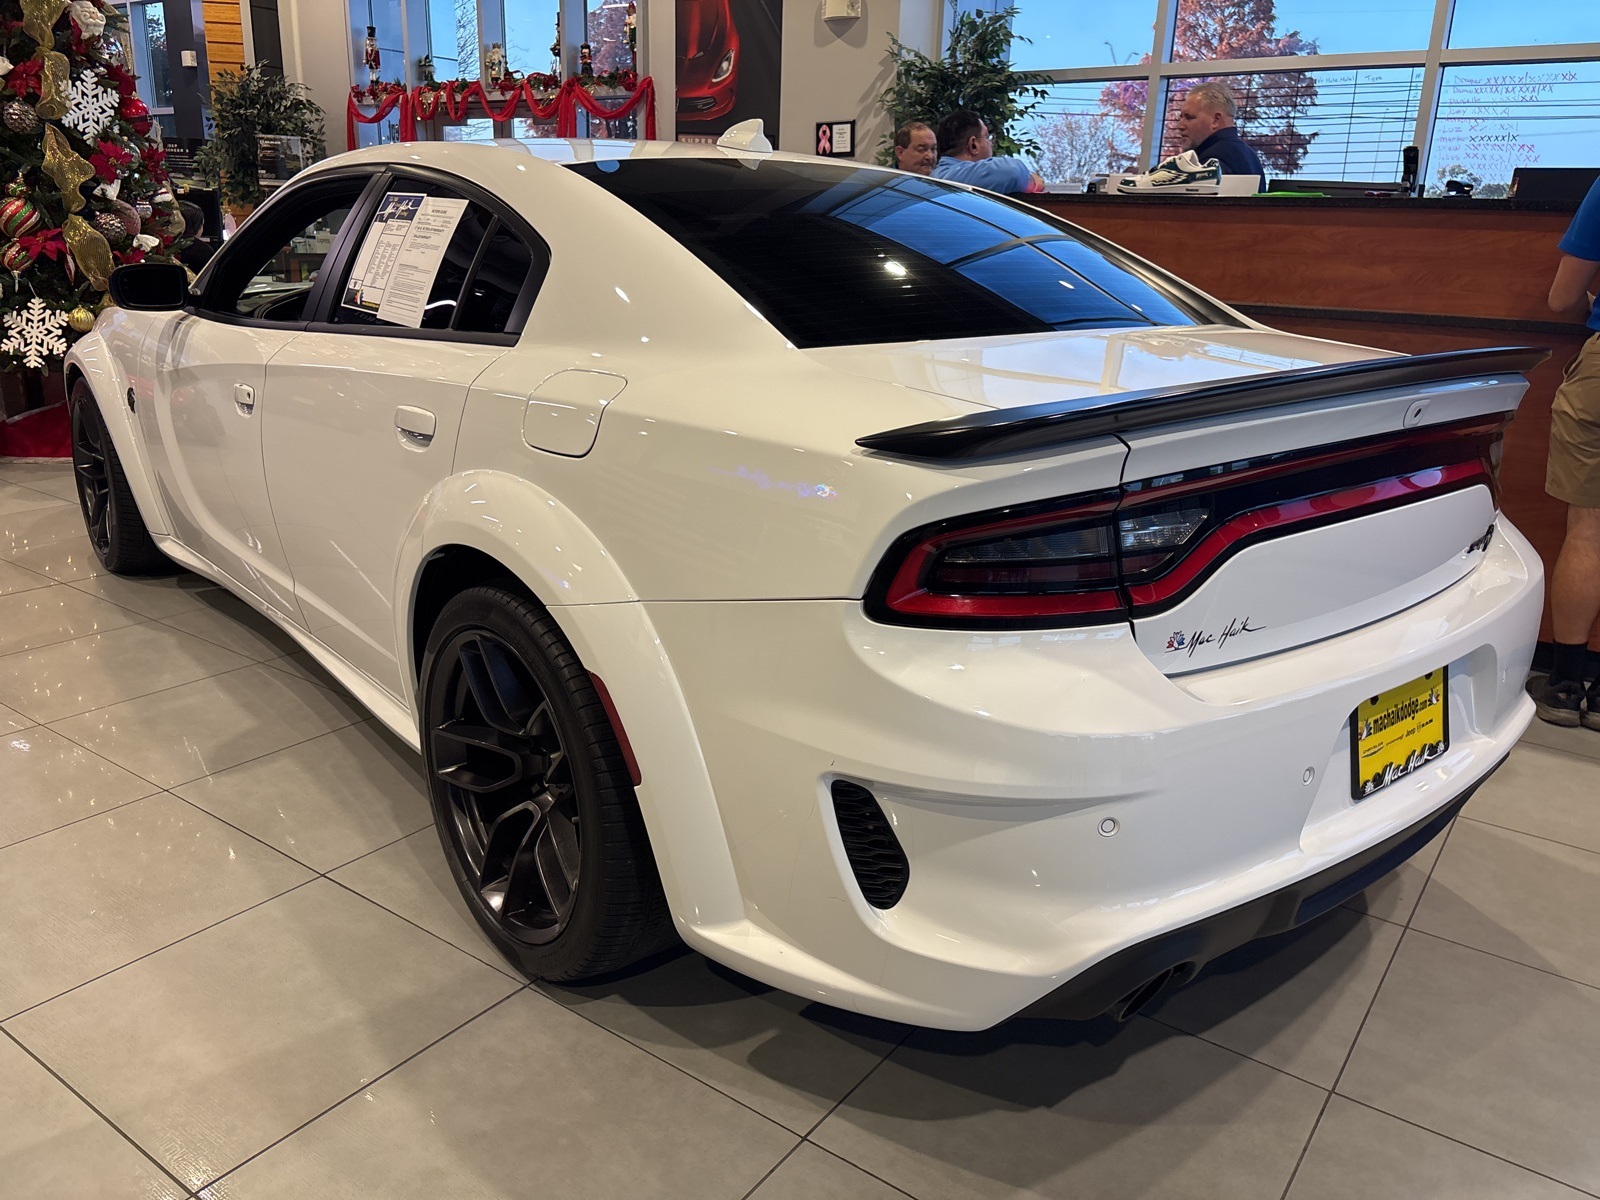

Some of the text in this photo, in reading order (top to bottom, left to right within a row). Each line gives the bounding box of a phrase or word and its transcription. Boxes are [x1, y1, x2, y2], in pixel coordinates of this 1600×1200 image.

[1185, 616, 1266, 657] Mac Haik
[1405, 727, 1416, 738] Jeep
[1380, 744, 1436, 786] Mac Haik
